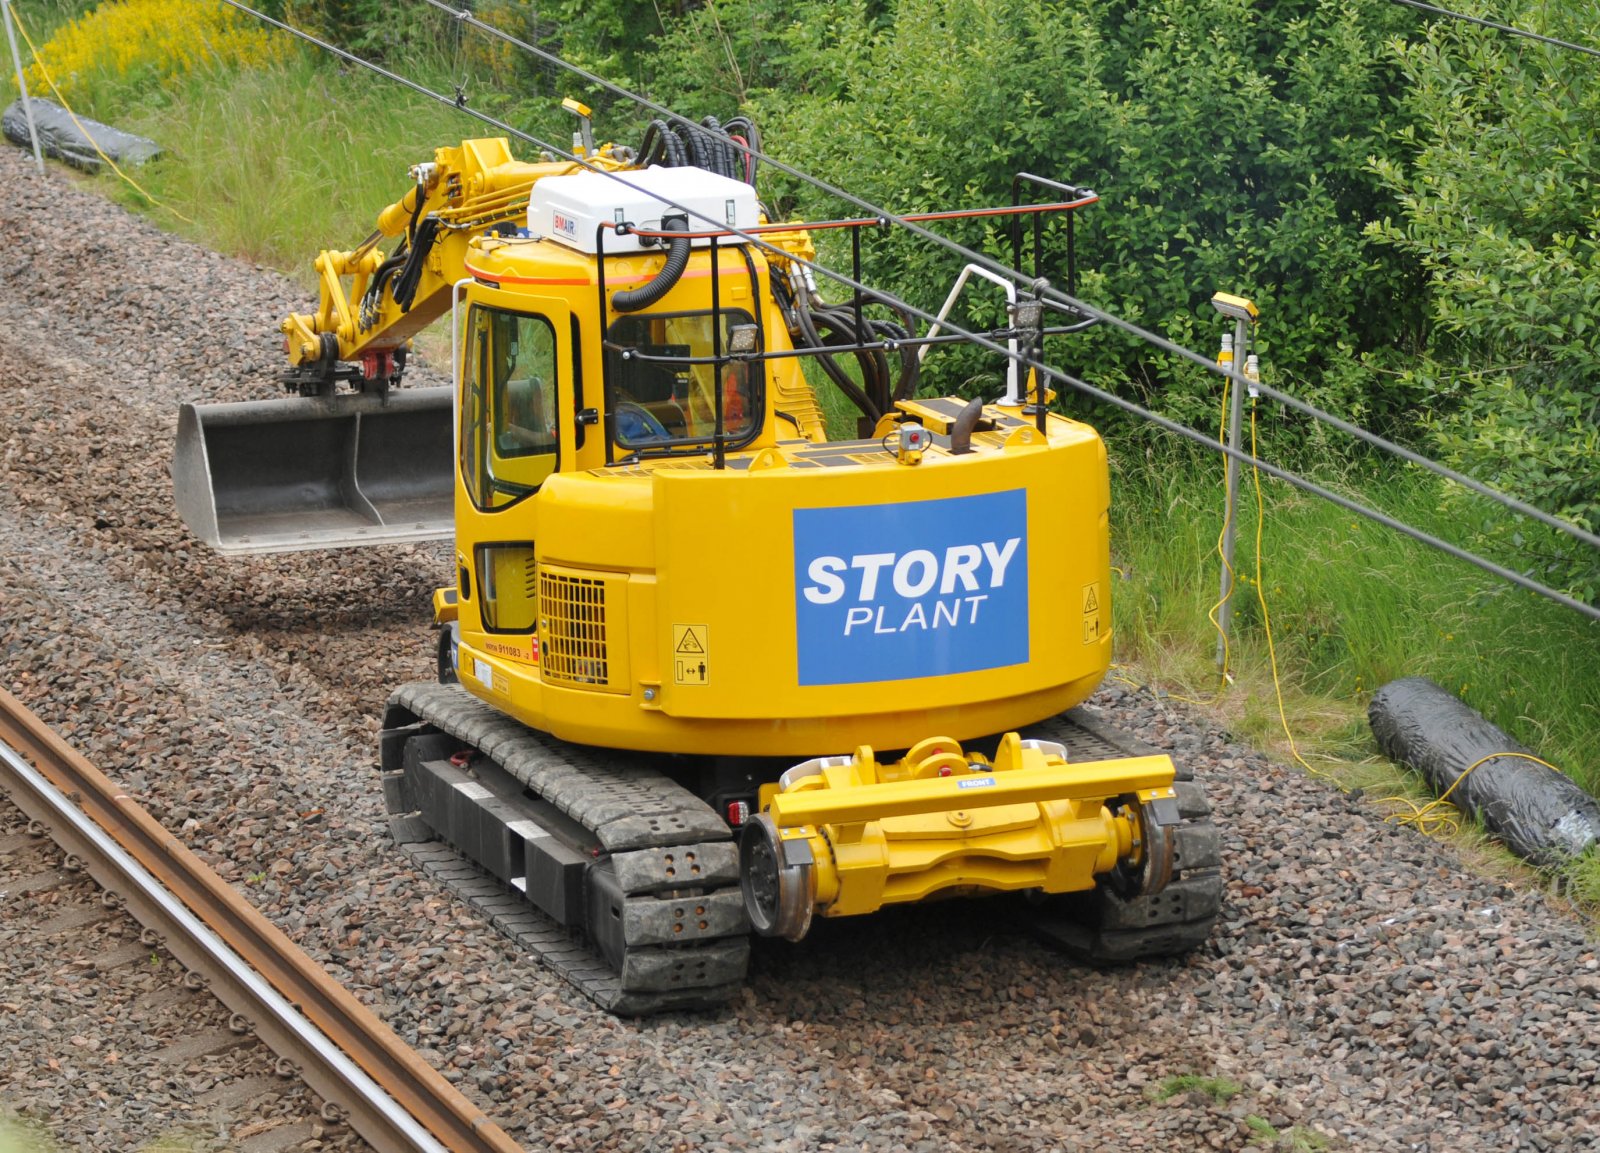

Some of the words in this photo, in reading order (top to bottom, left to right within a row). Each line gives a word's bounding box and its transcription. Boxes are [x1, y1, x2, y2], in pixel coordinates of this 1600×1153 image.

[554, 215, 575, 235] BMAIR
[803, 537, 1022, 605] STORY
[843, 594, 989, 637] PLANT
